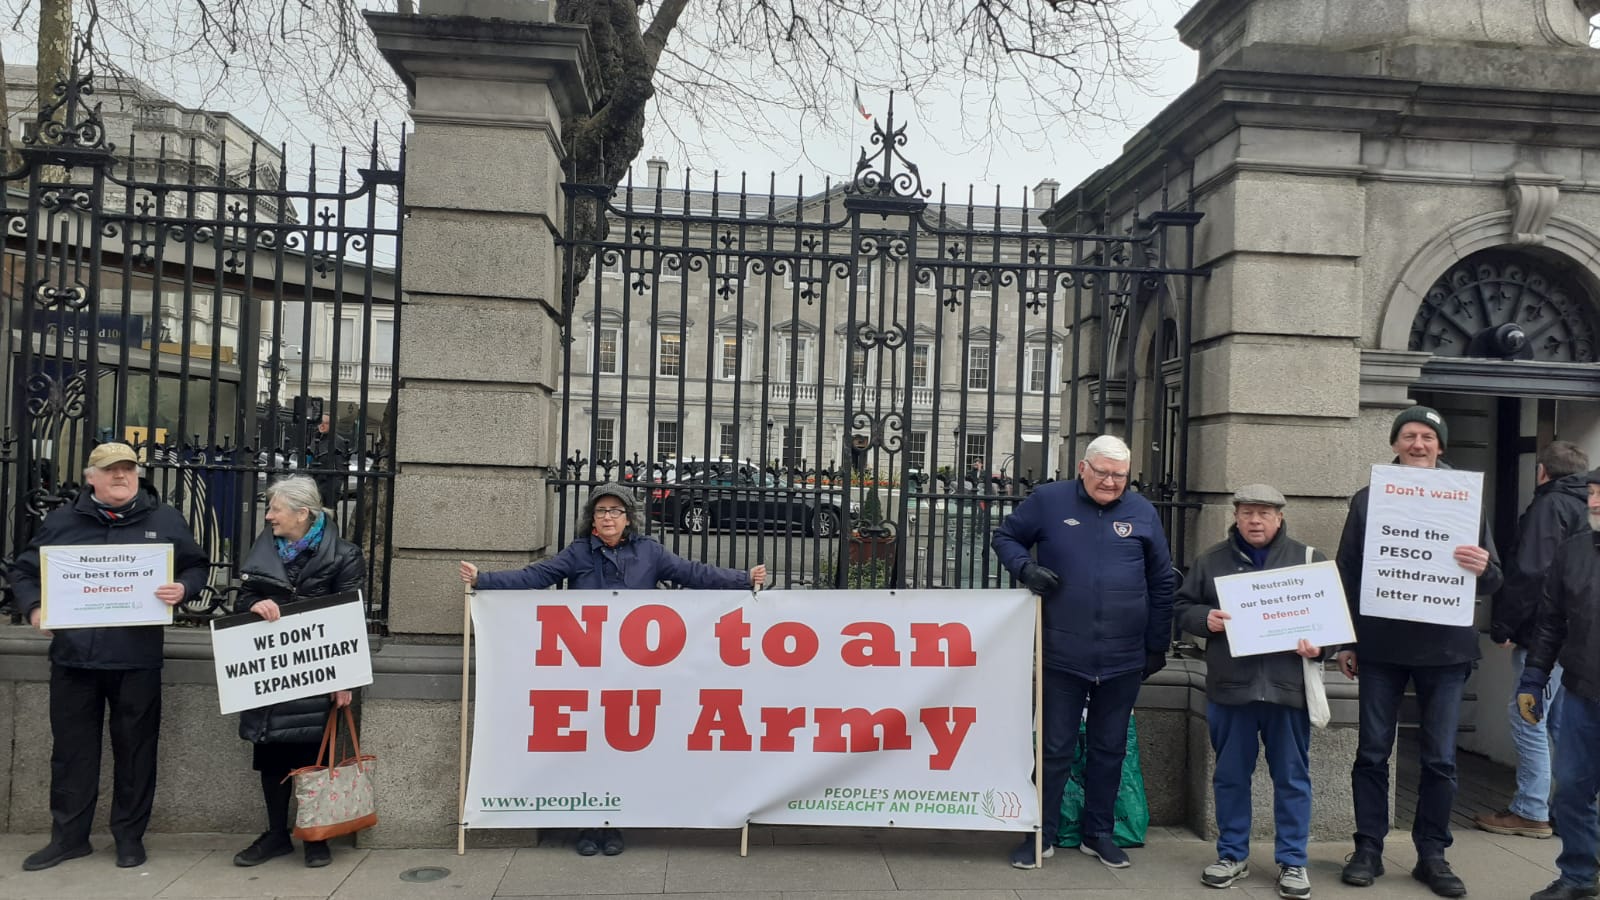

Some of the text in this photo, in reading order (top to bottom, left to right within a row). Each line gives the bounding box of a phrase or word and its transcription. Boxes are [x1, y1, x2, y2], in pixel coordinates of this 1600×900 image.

[1385, 484, 1470, 501] Don't wait!
[1381, 525, 1450, 542] Send the
[79, 555, 137, 564] Neutrality
[1379, 545, 1433, 561] PESCO
[62, 572, 81, 580] our
[84, 570, 110, 579] best
[113, 568, 139, 577] form
[1377, 567, 1465, 586] withdrawal
[83, 584, 134, 593] Defence!
[1251, 577, 1305, 592] Neutrality
[1240, 590, 1325, 609] our best form of
[1376, 587, 1460, 607] letter now!
[1262, 607, 1310, 620] Defence!
[253, 623, 326, 651] WE DON'T
[535, 604, 977, 668] NO to an
[225, 638, 360, 679] WANT EU MILITARY
[254, 665, 337, 696] EXPANSION
[527, 688, 977, 771] EU Army
[480, 791, 622, 811] www.people.ie
[824, 787, 981, 802] PEOPLE'S MOVEMENT
[787, 800, 980, 816] GLUAISEACHT AN PHOBAIL
